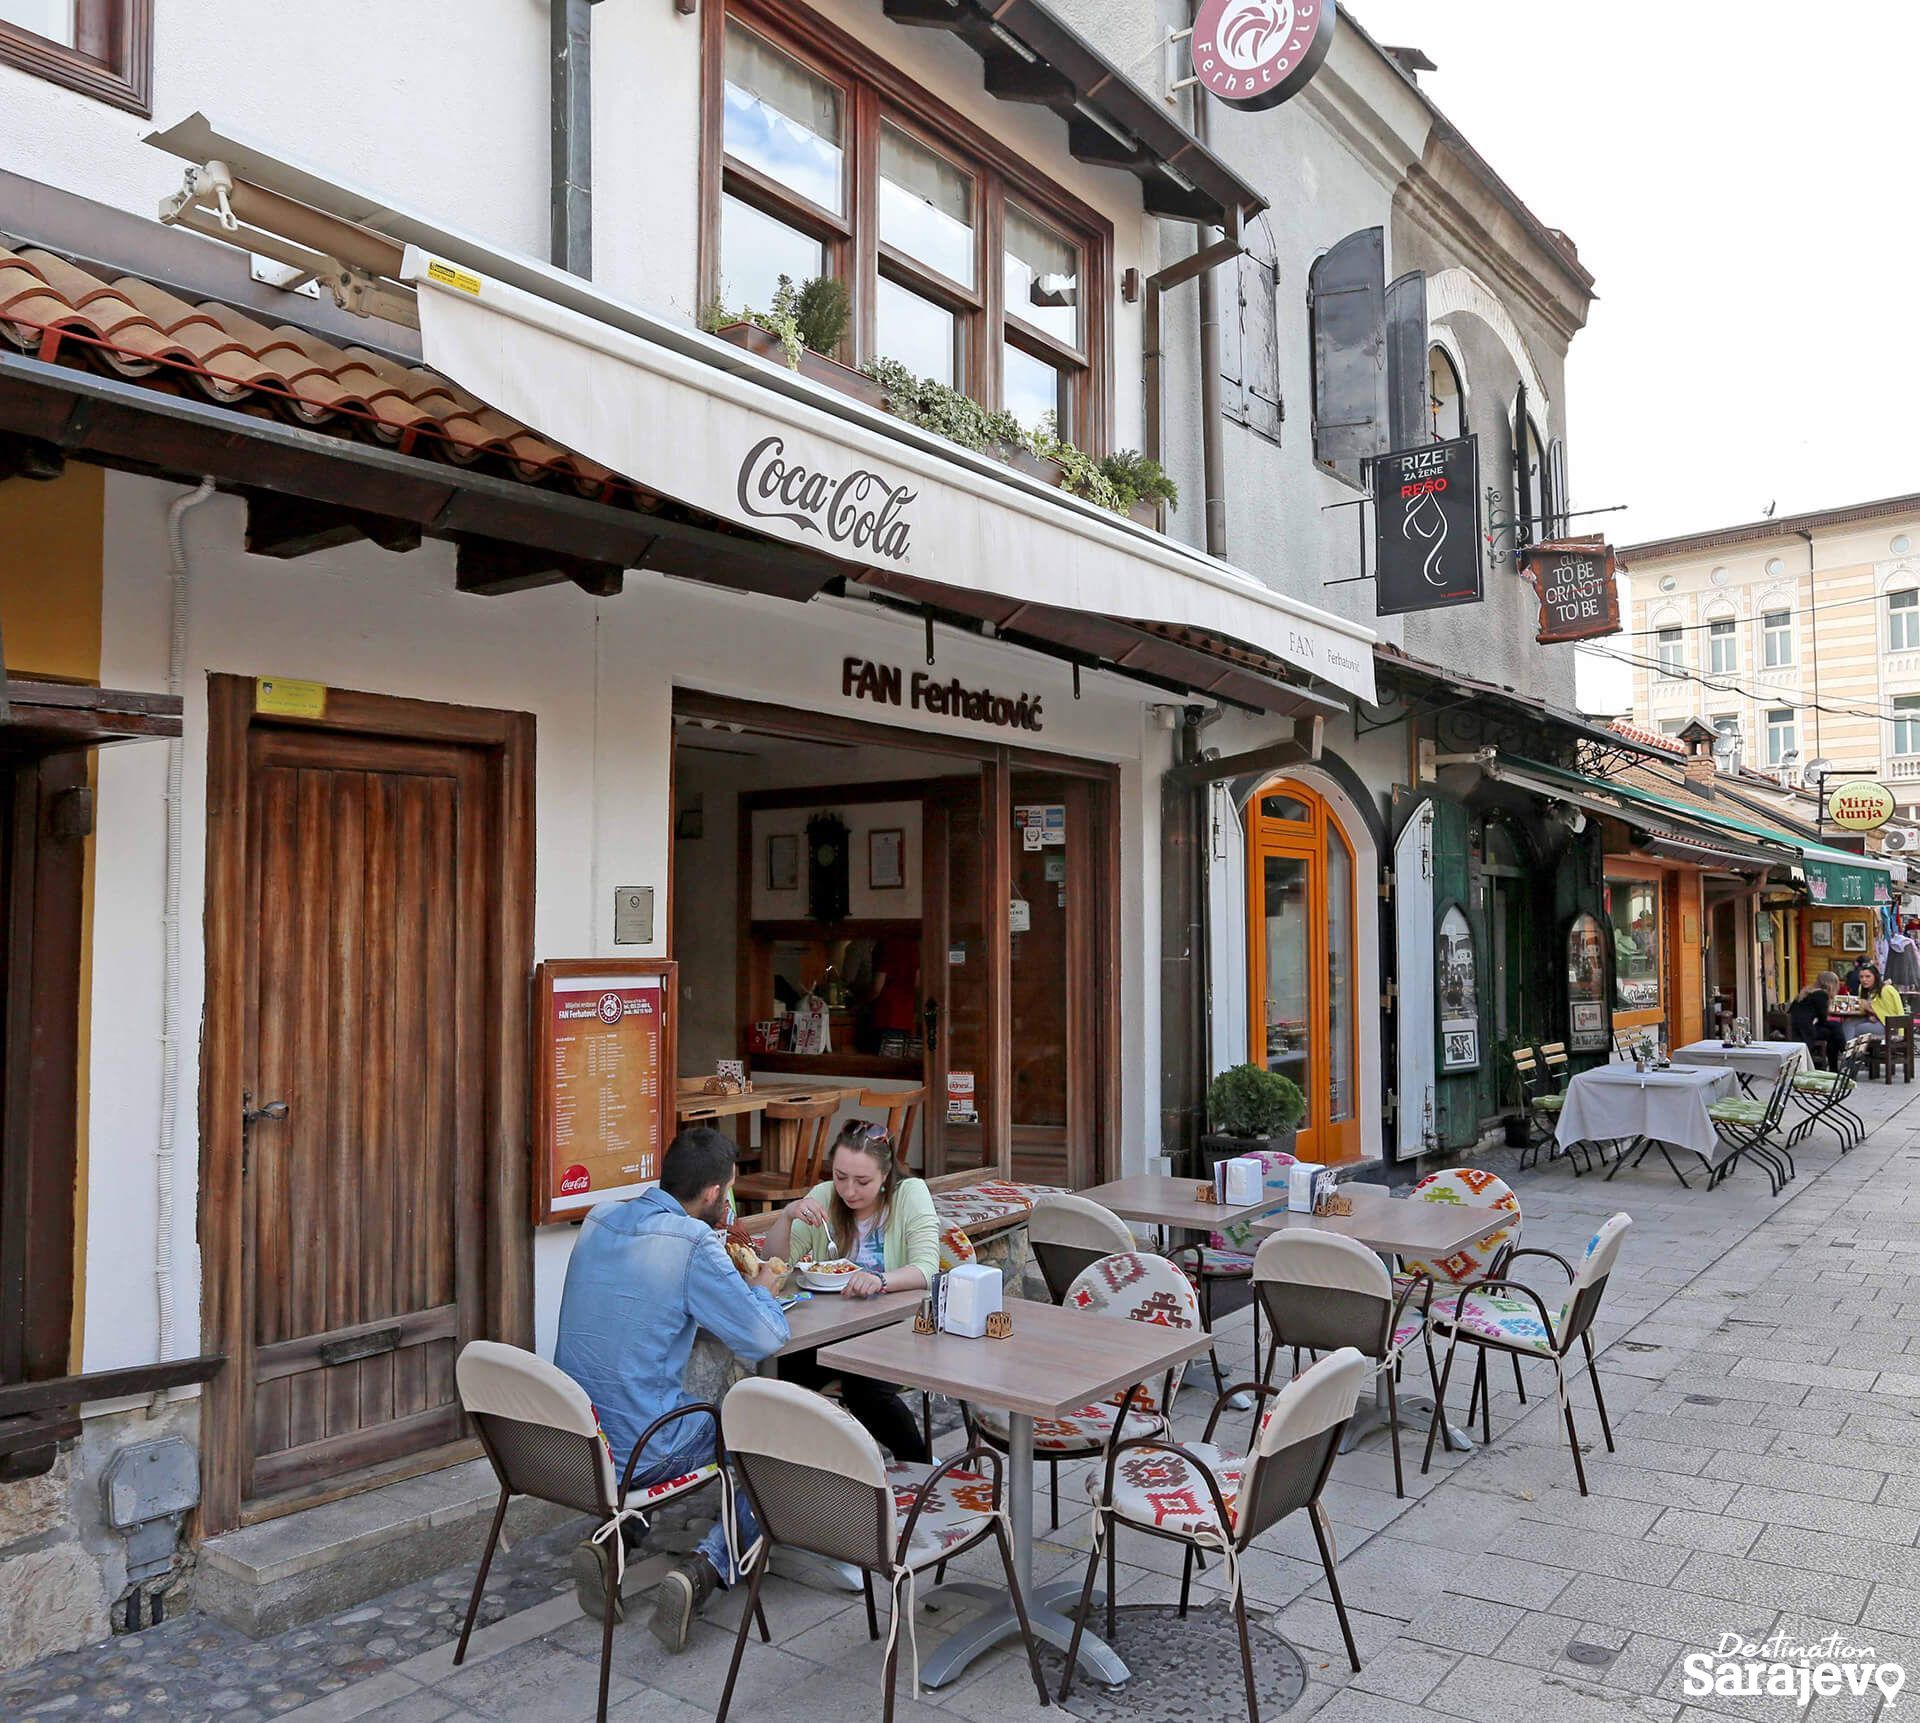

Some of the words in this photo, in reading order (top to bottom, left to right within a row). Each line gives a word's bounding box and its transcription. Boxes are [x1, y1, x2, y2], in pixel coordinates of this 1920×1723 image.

[1404, 472, 1417, 481] ZA
[1418, 466, 1444, 478] ŽENE
[737, 436, 919, 561] Coca-Cola
[1553, 566, 1574, 584] TO
[1577, 562, 1595, 581] BE
[1556, 602, 1577, 622] TO
[1581, 599, 1599, 618] BE
[1289, 631, 1314, 658] FAN
[842, 656, 902, 706] FAN
[910, 671, 1043, 731] Ferhatović
[1839, 796, 1884, 809] Miris
[1835, 807, 1883, 821] dunja
